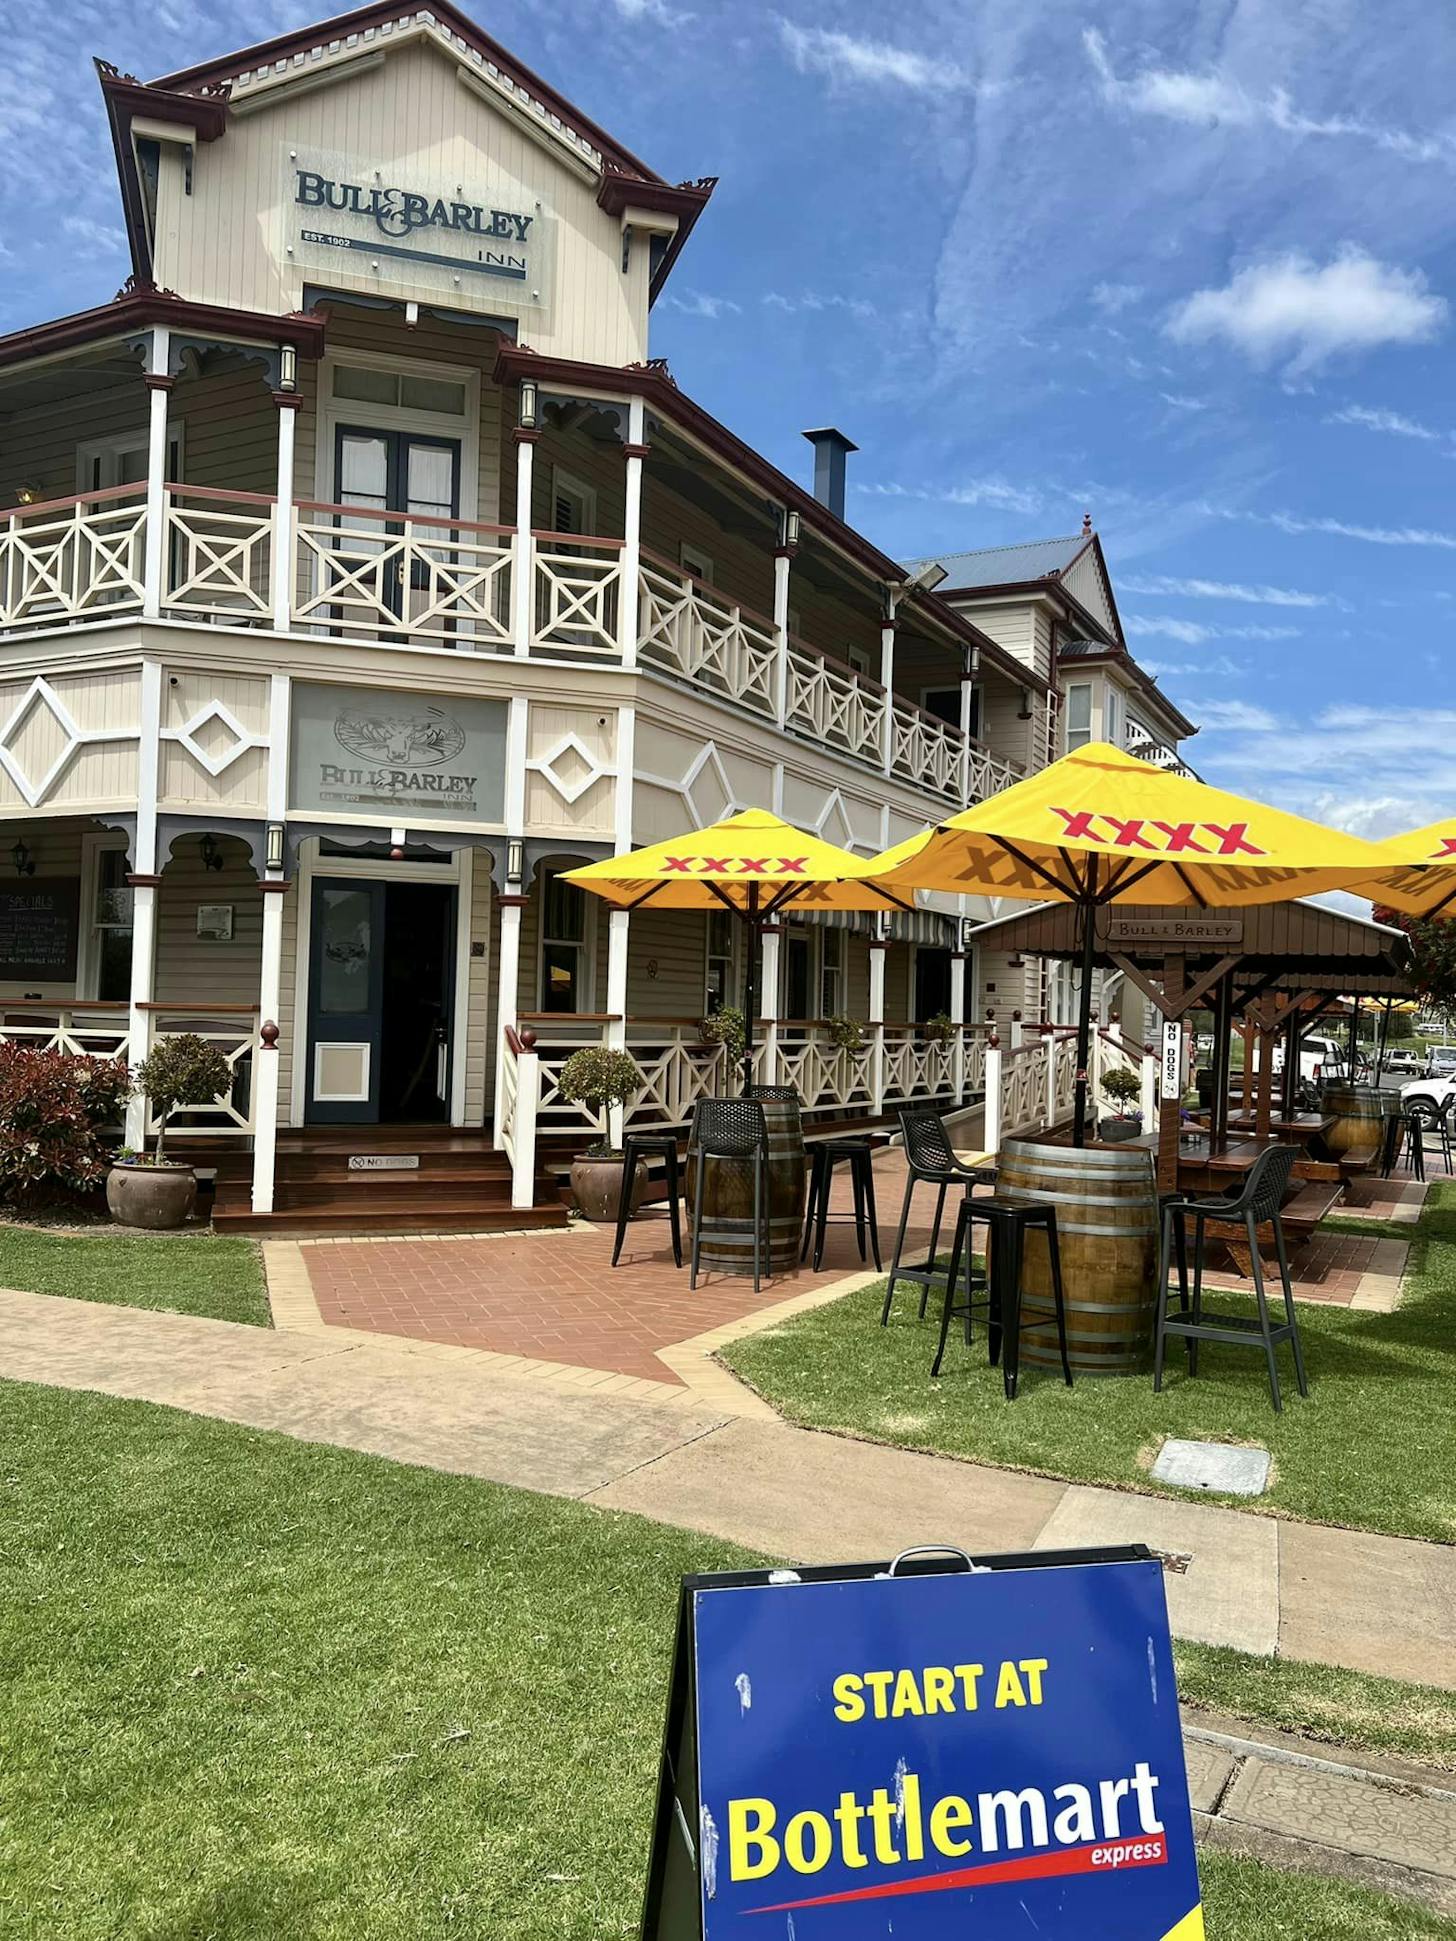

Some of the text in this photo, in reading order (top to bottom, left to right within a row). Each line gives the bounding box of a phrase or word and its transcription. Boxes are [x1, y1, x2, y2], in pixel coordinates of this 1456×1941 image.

[401, 192, 533, 242] BARLEY
[304, 232, 351, 248] EST. 1902
[478, 250, 526, 269] INN
[389, 770, 478, 794] BARLEY
[1049, 807, 1268, 855] XXXX
[659, 857, 809, 873] XXXX
[1119, 923, 1159, 936] BULL
[1175, 923, 1233, 936] BARLEY
[1167, 1025, 1176, 1080] NO DOGS
[832, 1658, 1049, 1722] START AT
[729, 1763, 1165, 1882] Bottlemart
[1091, 1841, 1162, 1868] express
